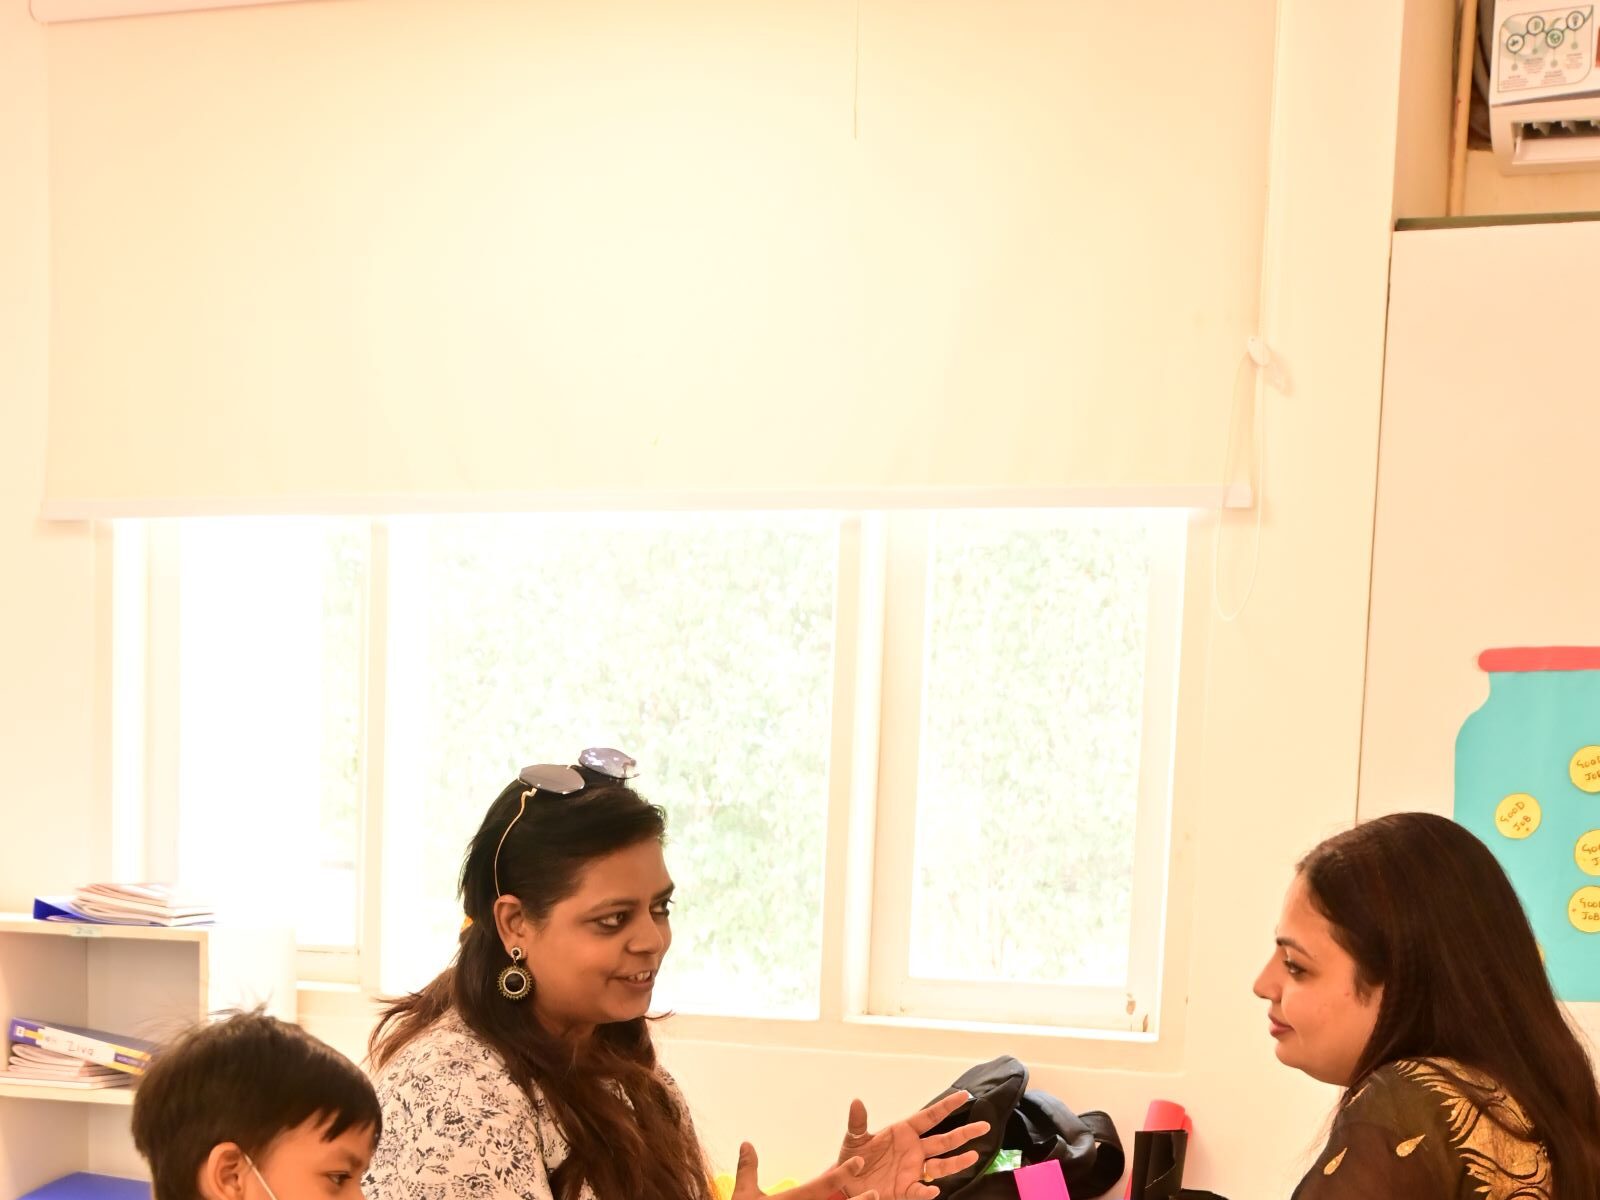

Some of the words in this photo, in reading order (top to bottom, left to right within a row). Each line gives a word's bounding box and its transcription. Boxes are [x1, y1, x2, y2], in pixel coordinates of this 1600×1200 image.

[1499, 801, 1525, 823] GOOD
[1512, 815, 1532, 832] JOB
[1579, 897, 1600, 909] GOO
